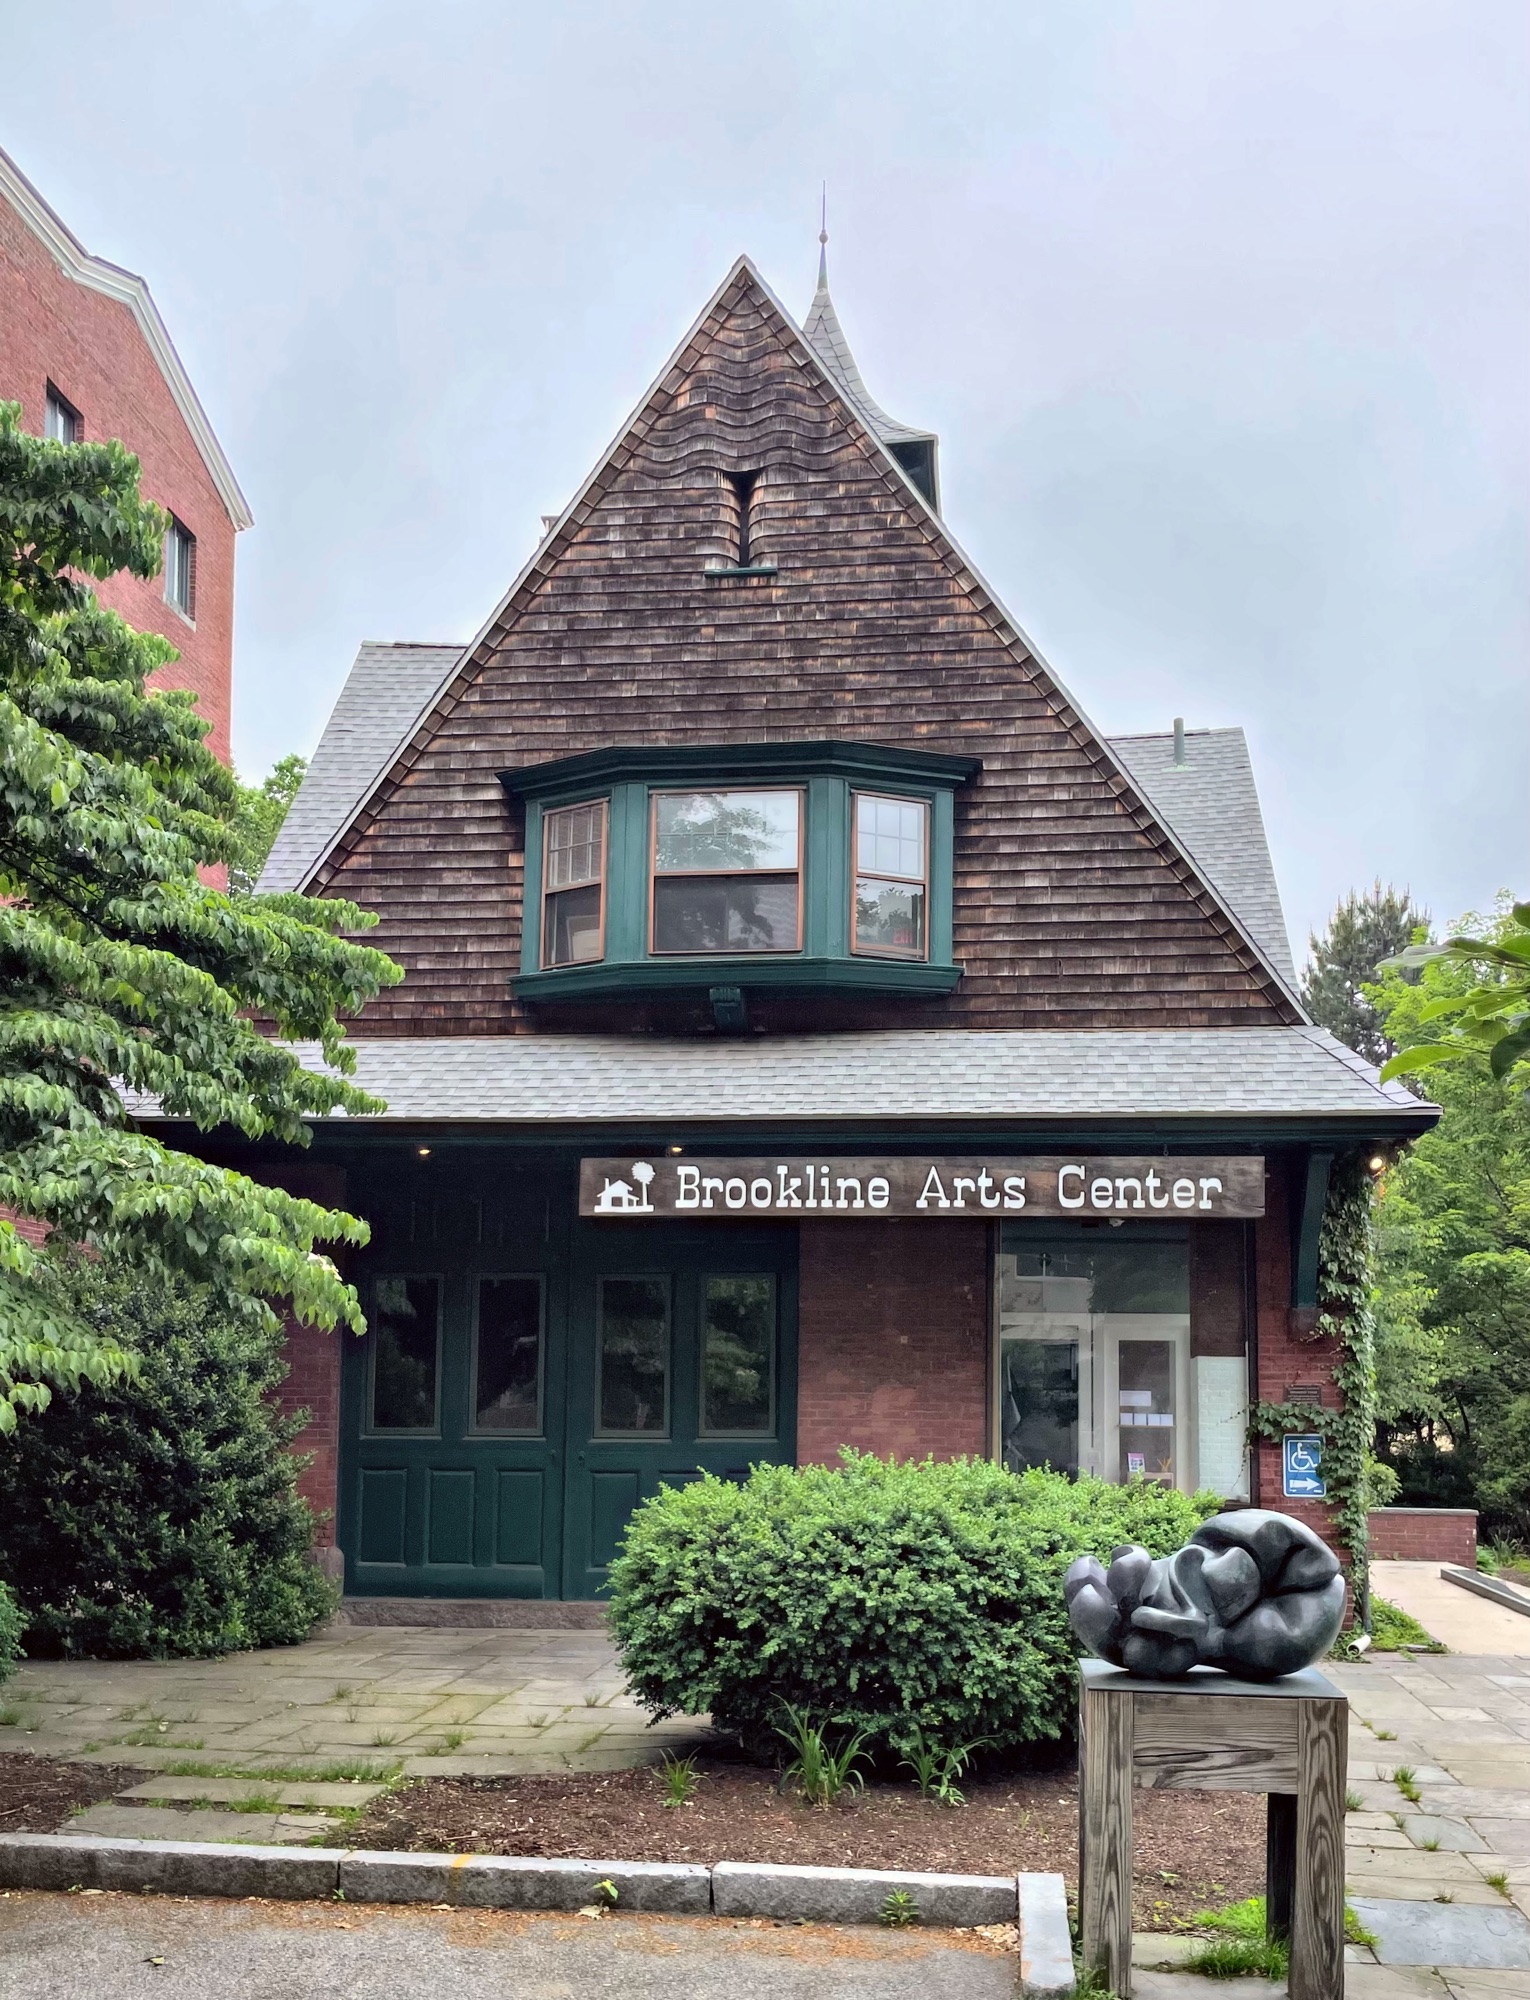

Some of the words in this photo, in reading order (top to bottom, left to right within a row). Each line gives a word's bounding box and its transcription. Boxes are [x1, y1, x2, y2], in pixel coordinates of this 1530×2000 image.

[675, 1165, 890, 1209] Brookline
[916, 1165, 1026, 1209] Arts
[1059, 1164, 1223, 1210] Center
